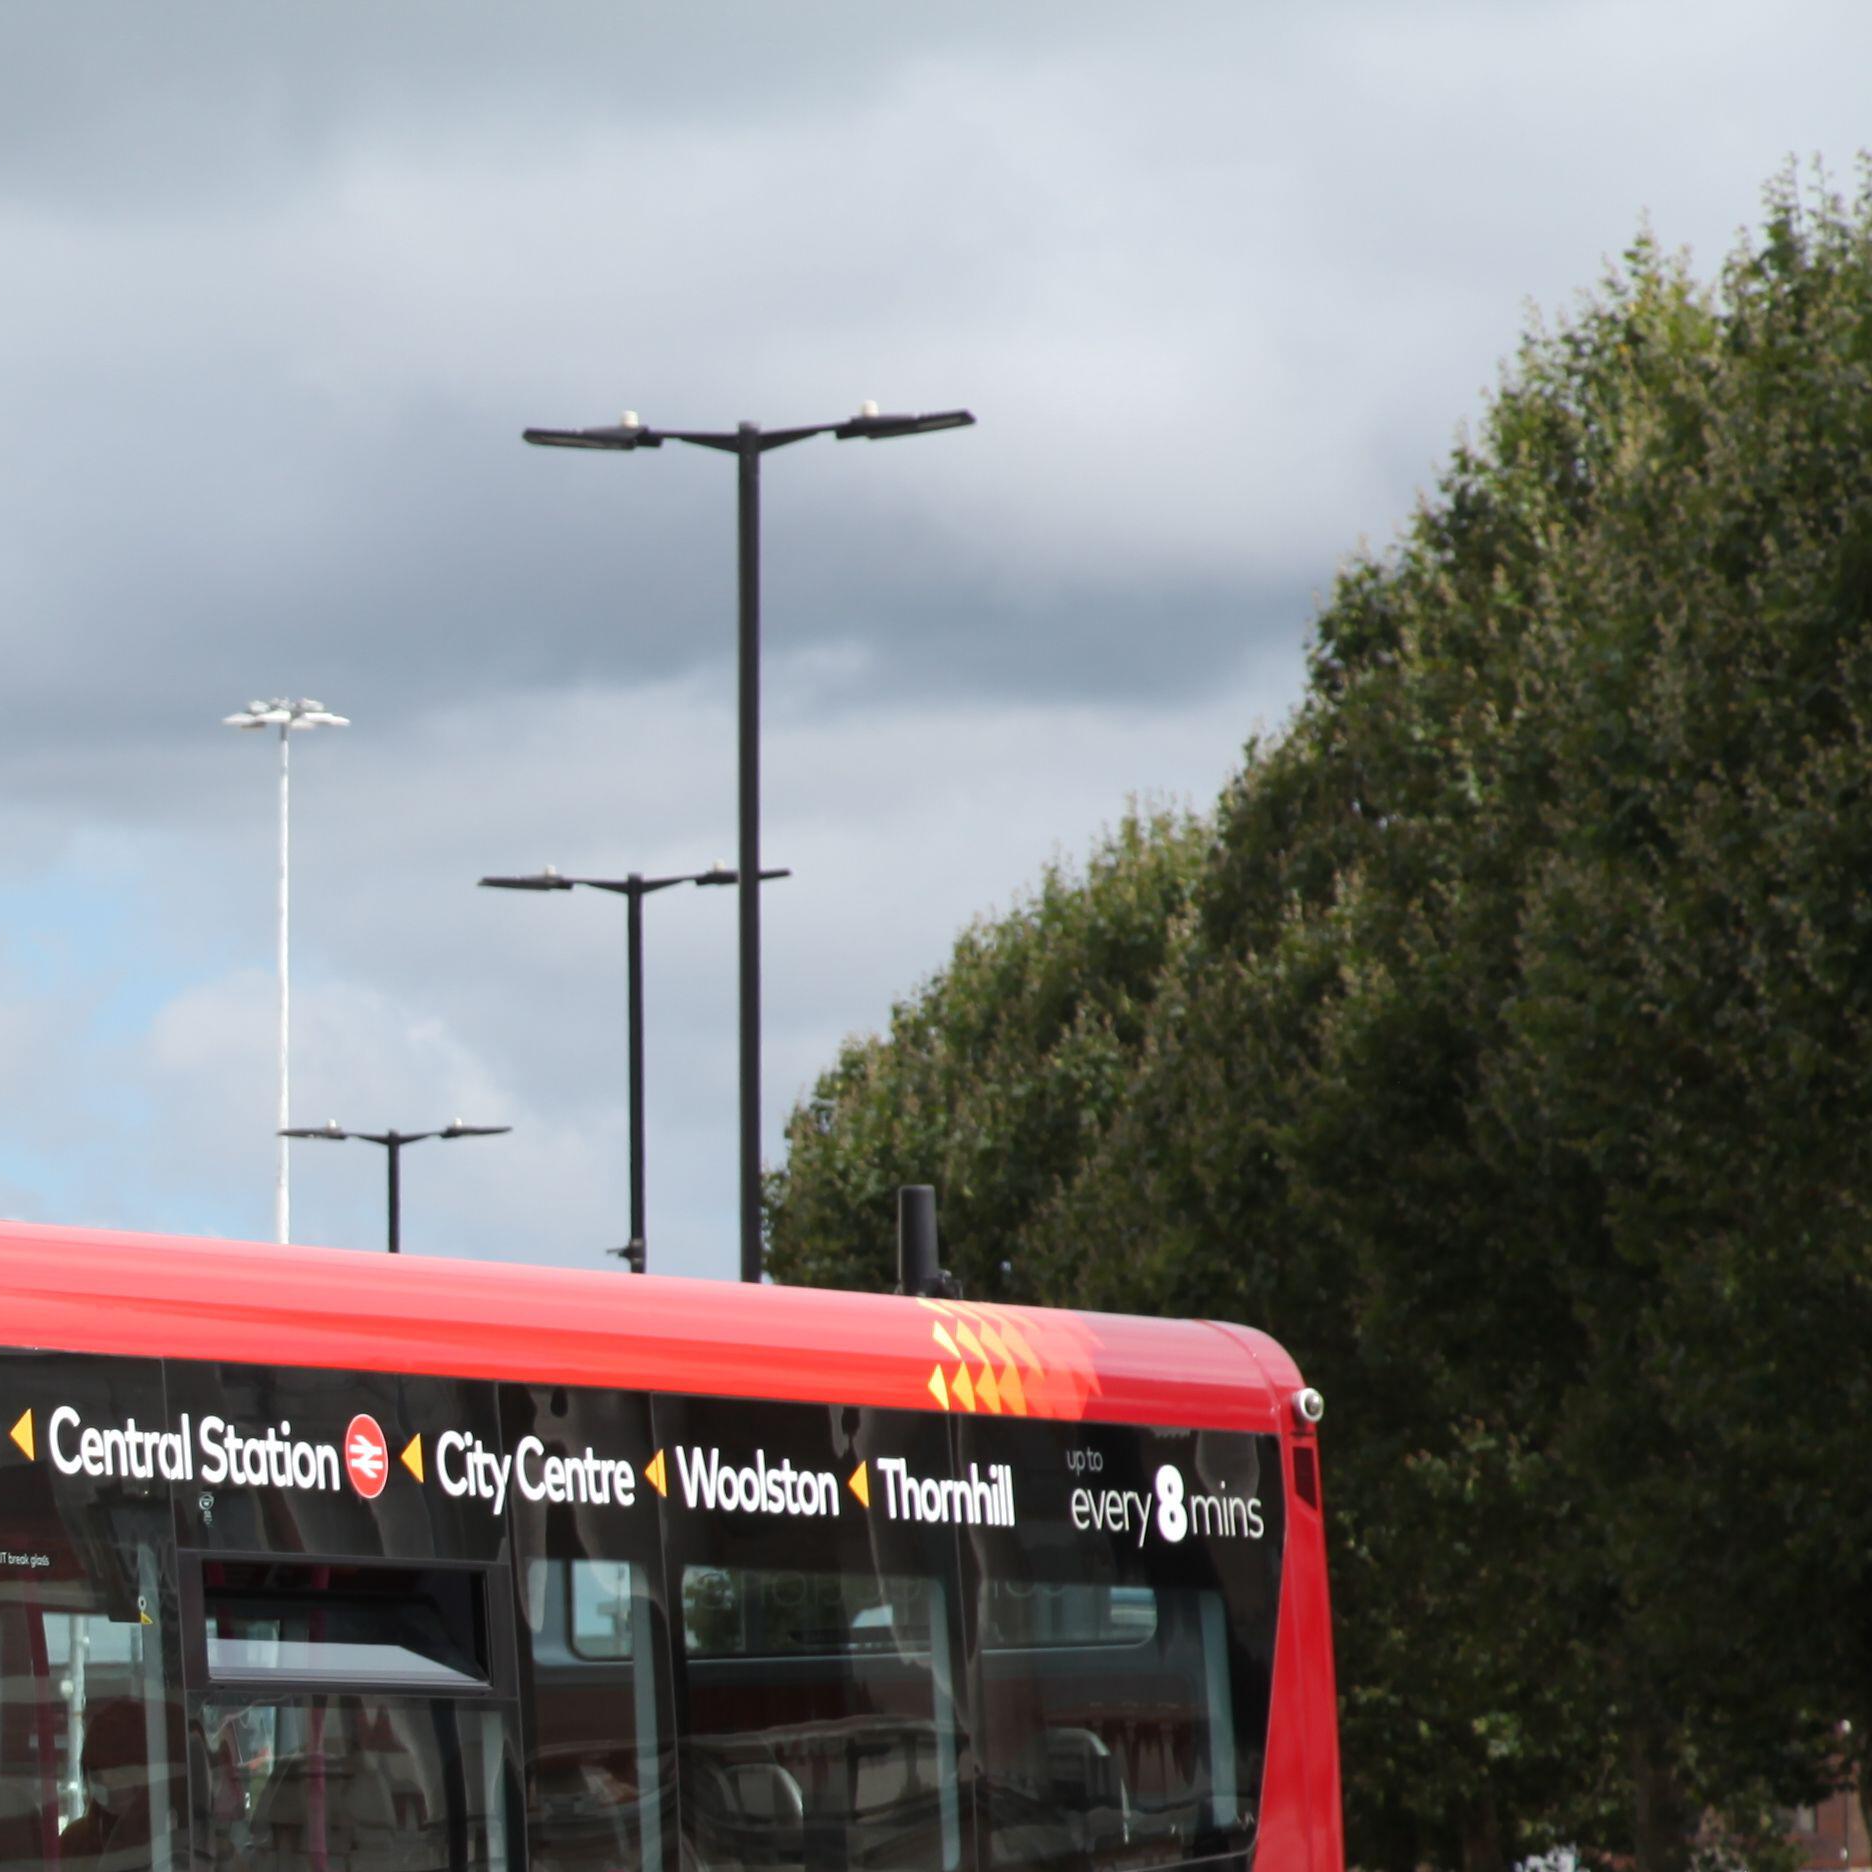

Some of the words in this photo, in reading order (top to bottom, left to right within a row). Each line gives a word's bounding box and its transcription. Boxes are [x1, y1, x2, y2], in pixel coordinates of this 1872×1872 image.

[49, 1406, 192, 1482] Central
[200, 1413, 341, 1490] Station
[436, 1429, 511, 1515] City
[516, 1435, 635, 1506] Centre
[676, 1446, 839, 1518] Woolston
[877, 1458, 1016, 1528] Thornhill
[1066, 1451, 1087, 1476] up
[1088, 1450, 1104, 1473] to
[1071, 1488, 1152, 1546] every
[1155, 1465, 1188, 1543] 8
[1190, 1480, 1265, 1541] mins
[8, 1552, 29, 1565] break
[30, 1554, 50, 1568] glass
